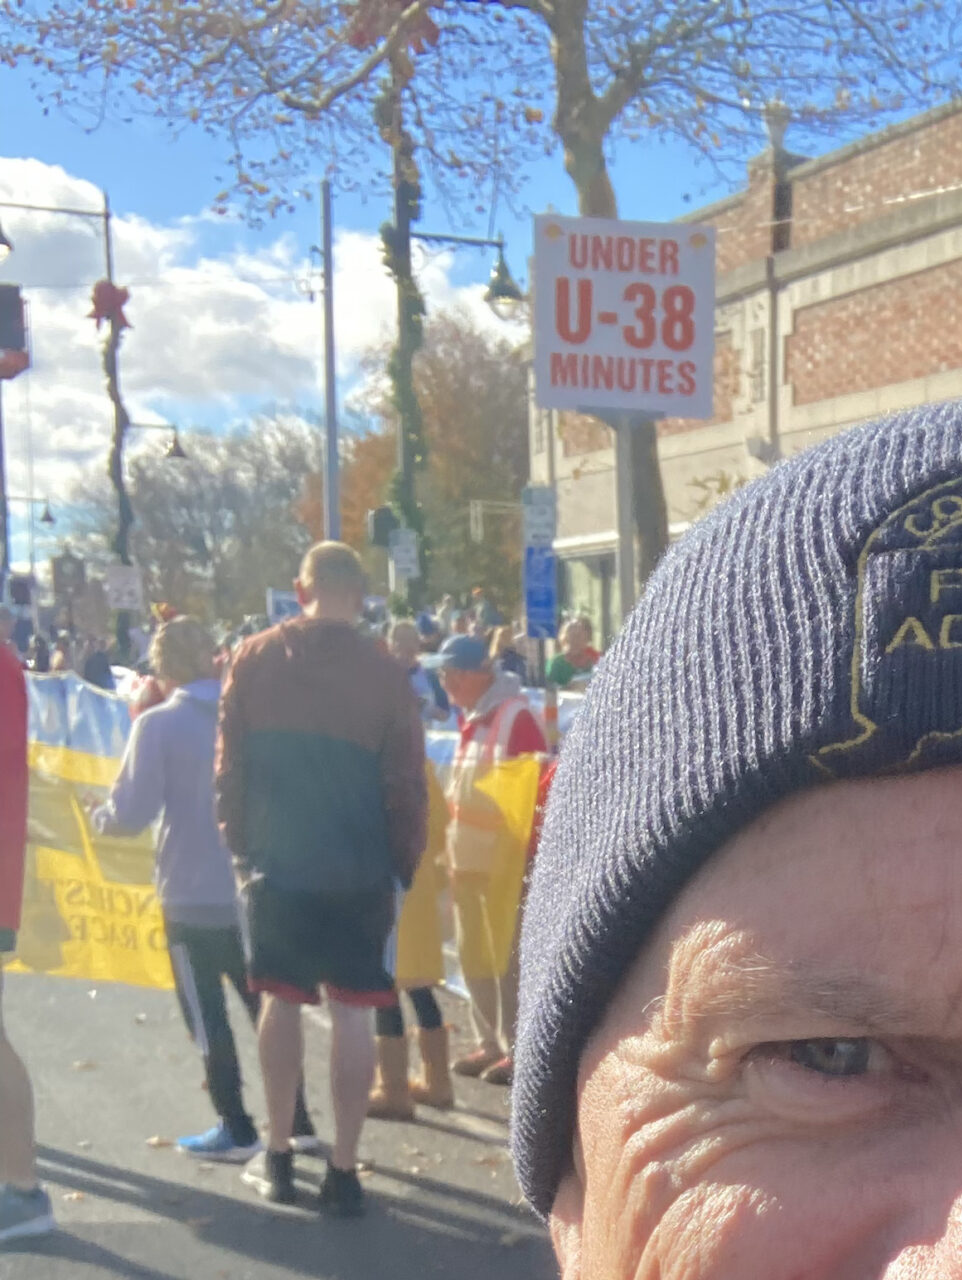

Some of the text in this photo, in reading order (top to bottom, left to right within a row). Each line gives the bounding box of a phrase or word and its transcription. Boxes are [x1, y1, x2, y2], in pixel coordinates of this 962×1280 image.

[569, 234, 680, 276] UNDER
[555, 276, 696, 352] U-38
[550, 352, 697, 396] MINUTES
